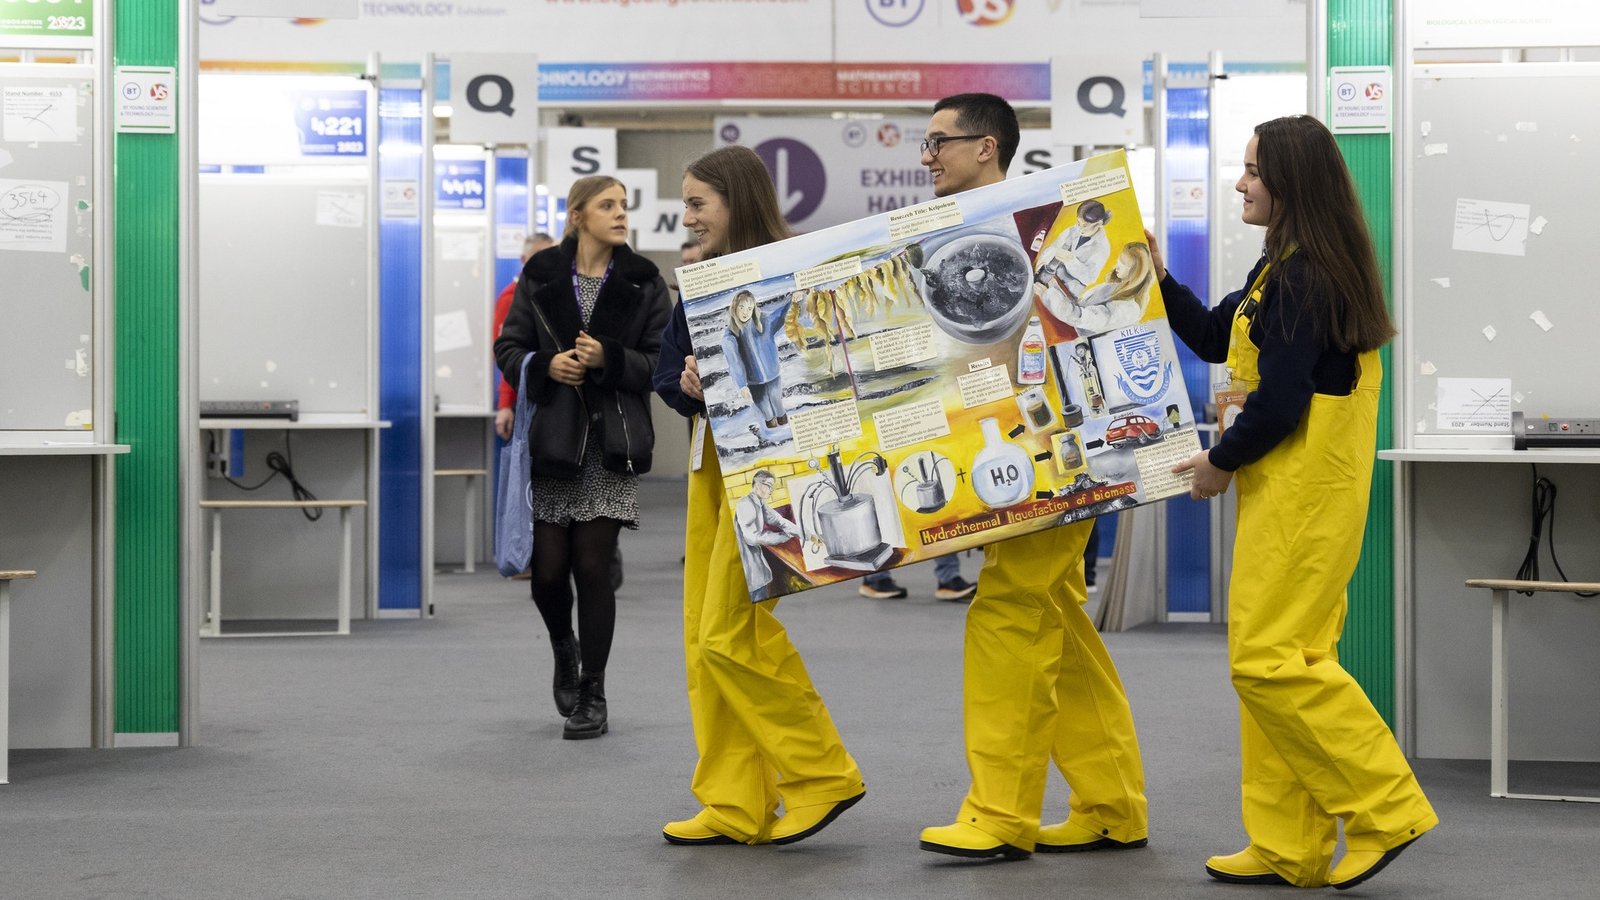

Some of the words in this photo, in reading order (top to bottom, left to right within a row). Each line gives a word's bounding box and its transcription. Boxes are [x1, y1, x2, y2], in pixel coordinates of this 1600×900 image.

[362, 2, 453, 17] TECHNOLOGY
[466, 74, 515, 117] Q
[837, 82, 921, 95] SCIENCE
[1076, 75, 1126, 118] Q
[310, 116, 362, 136] 4221
[571, 146, 600, 175] S
[9, 190, 48, 210] 3564
[889, 211, 913, 221] Research
[928, 200, 955, 212] Kelpoleum
[681, 264, 704, 274] Research
[921, 513, 1002, 545] Hydrothermal
[1006, 500, 1069, 525] liquefaction
[1076, 495, 1087, 505] of
[1093, 484, 1136, 500] biomass
